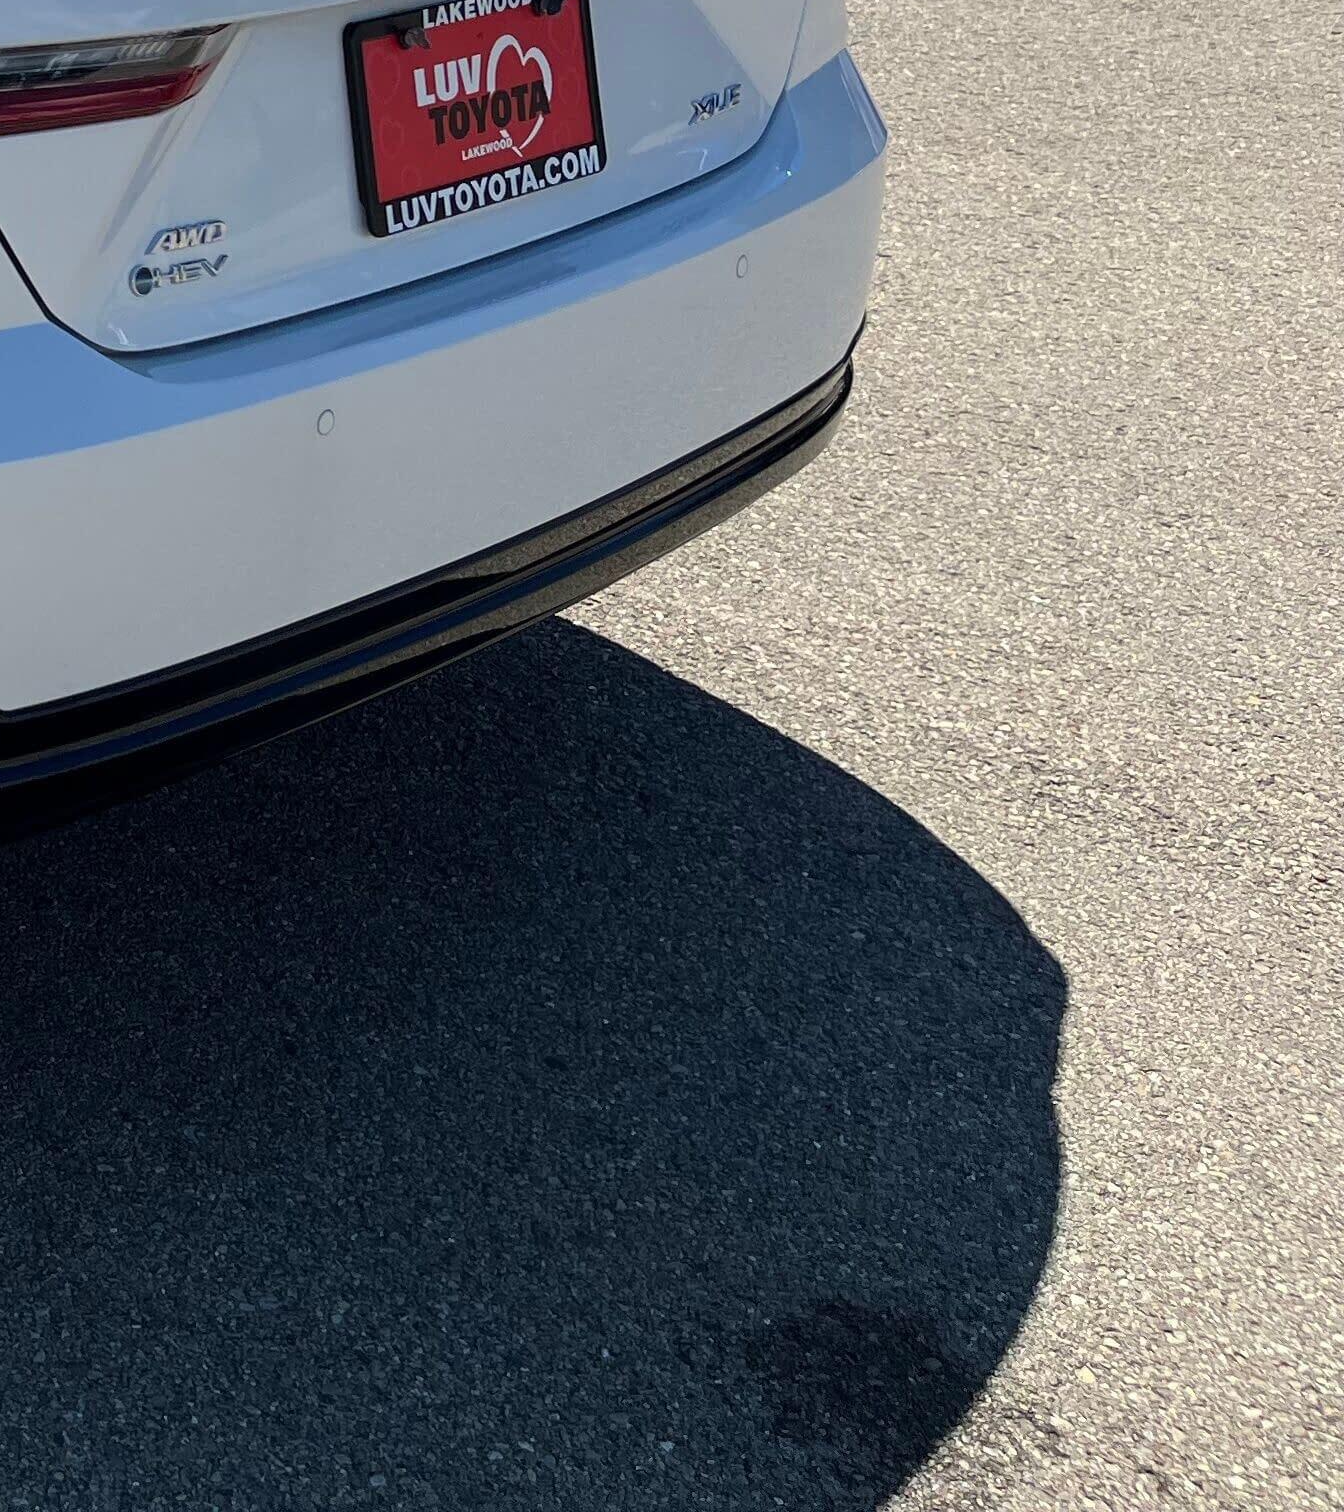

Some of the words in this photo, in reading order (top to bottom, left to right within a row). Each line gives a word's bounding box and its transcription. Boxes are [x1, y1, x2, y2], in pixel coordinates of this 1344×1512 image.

[413, 54, 482, 108] LUV
[688, 82, 743, 126] XLE
[429, 80, 551, 146] TOYOTA
[461, 136, 514, 161] LAKEWOOD
[385, 144, 601, 234] LUVTOYOTA.COM
[144, 220, 227, 256] AWD
